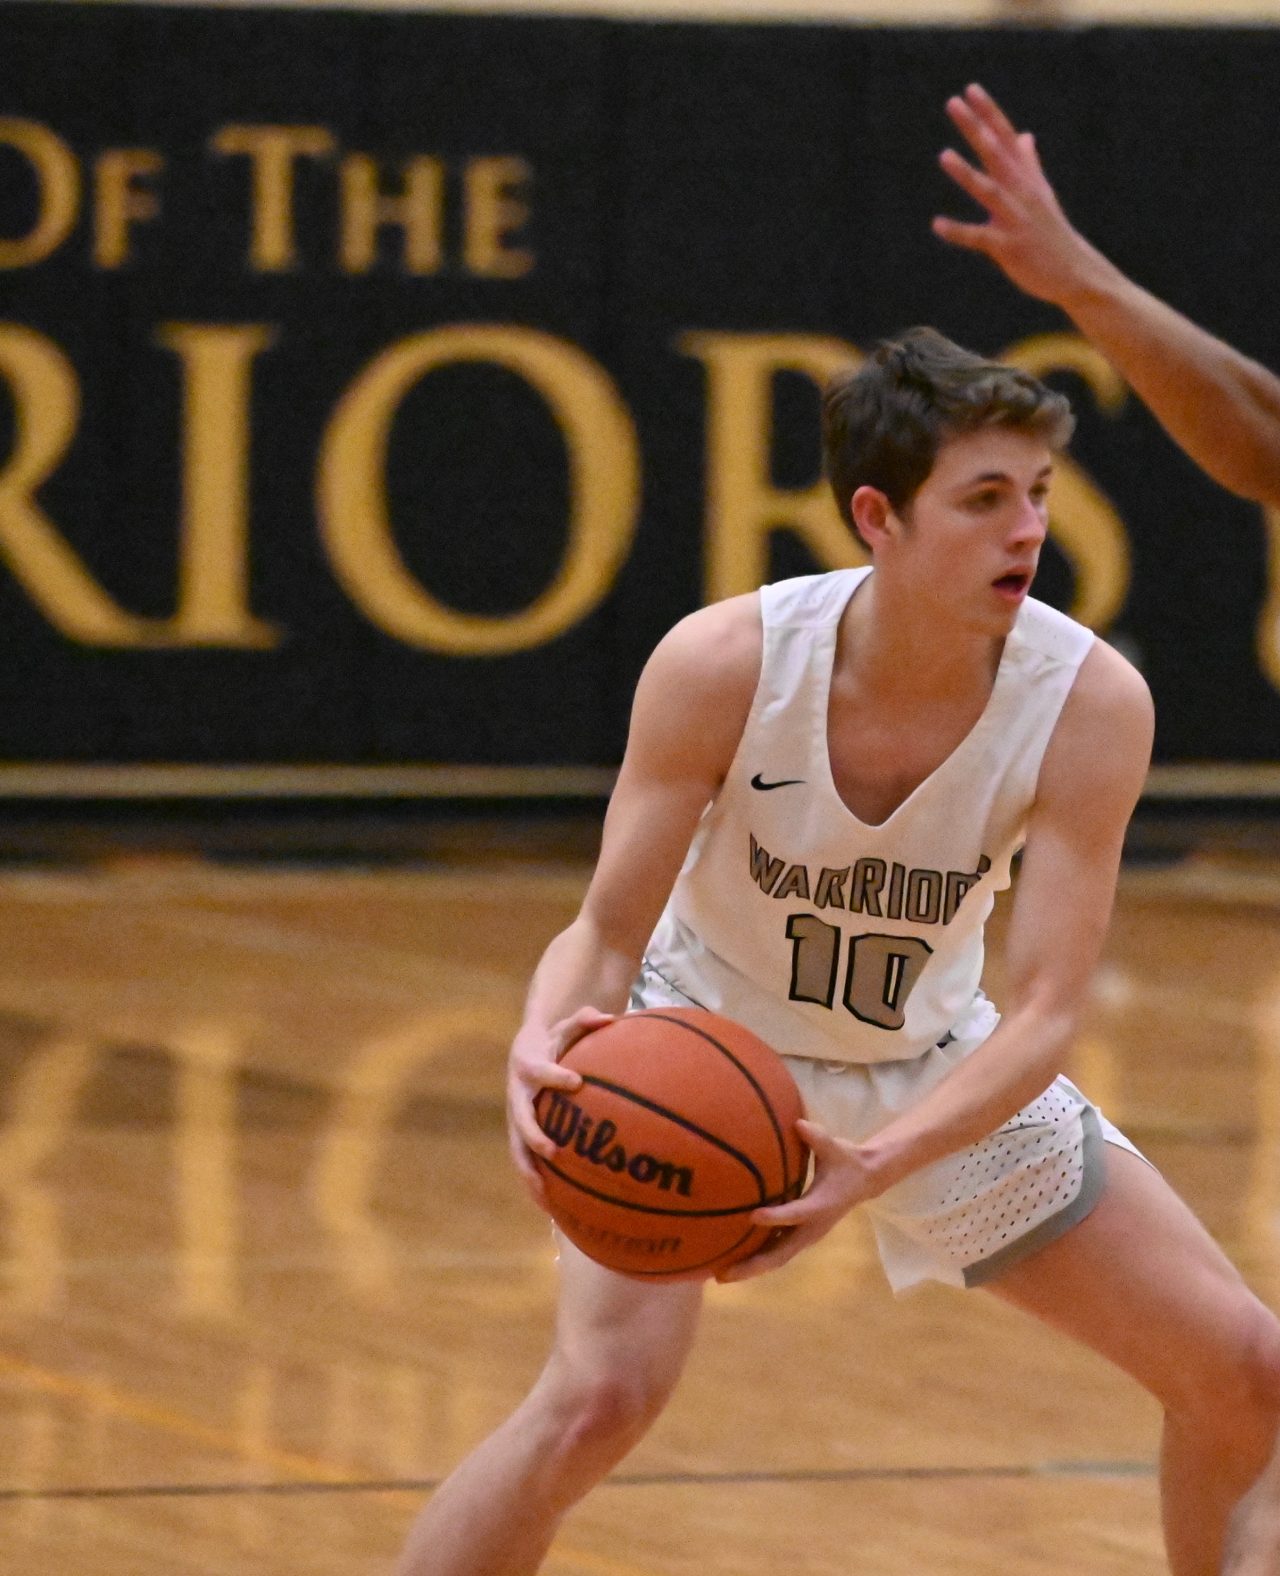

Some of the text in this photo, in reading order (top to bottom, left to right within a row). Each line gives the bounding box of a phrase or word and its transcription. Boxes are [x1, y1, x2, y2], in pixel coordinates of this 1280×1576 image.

[209, 122, 536, 278] THE
[785, 913, 934, 1030] 10
[543, 1092, 695, 1197] Wilson
